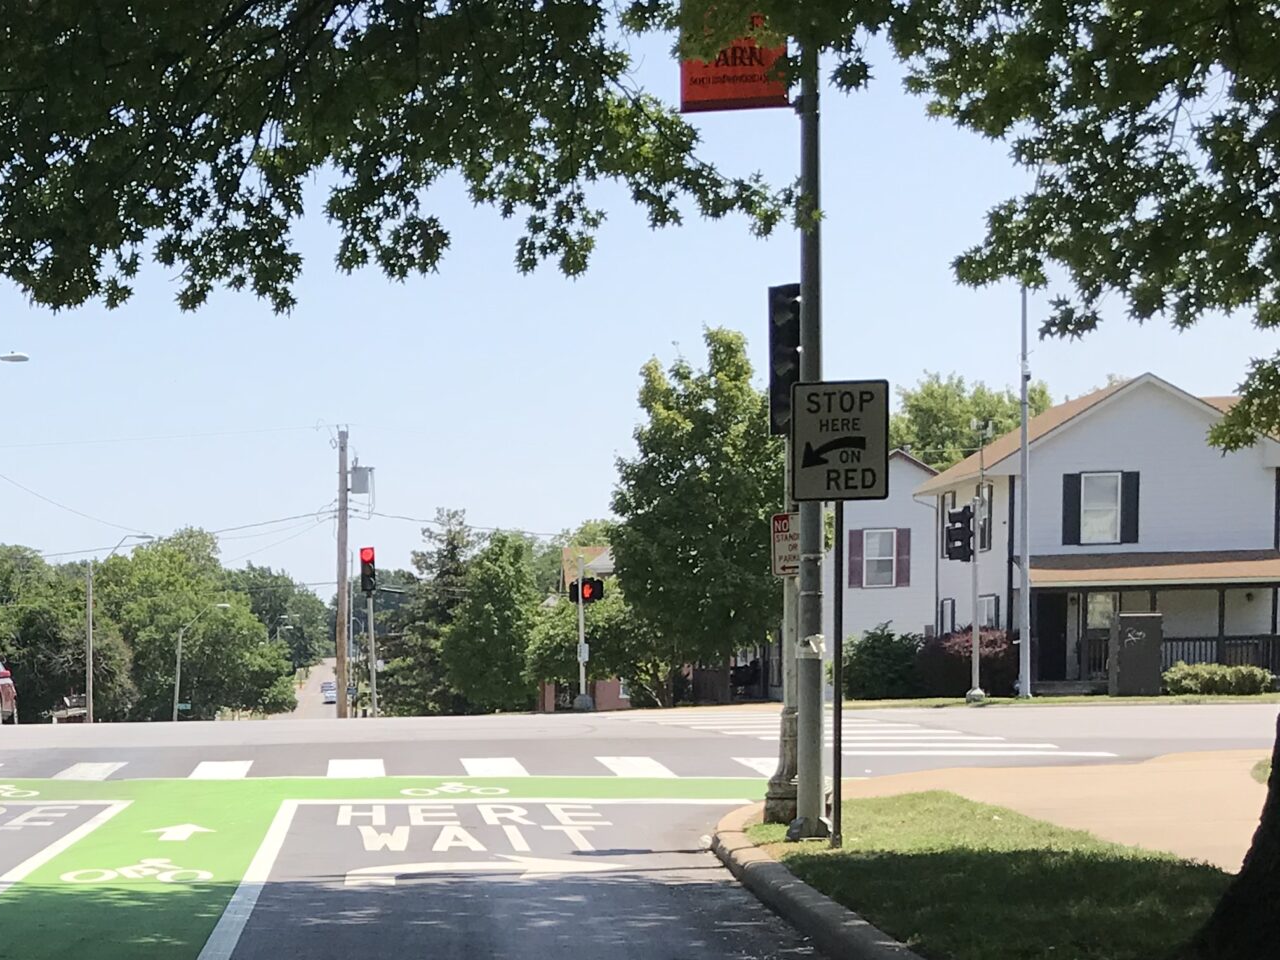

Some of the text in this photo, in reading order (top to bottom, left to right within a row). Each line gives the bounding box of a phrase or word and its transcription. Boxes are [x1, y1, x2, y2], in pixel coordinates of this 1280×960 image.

[806, 390, 875, 413] STOP
[819, 417, 861, 433] HERE
[839, 450, 861, 464] ON
[826, 468, 877, 491] RED
[774, 519, 789, 532] NO
[775, 532, 800, 543] STAND
[787, 543, 798, 552] OR
[778, 554, 800, 562] PARK
[336, 804, 613, 826] HERE
[357, 825, 597, 851] WAIT
